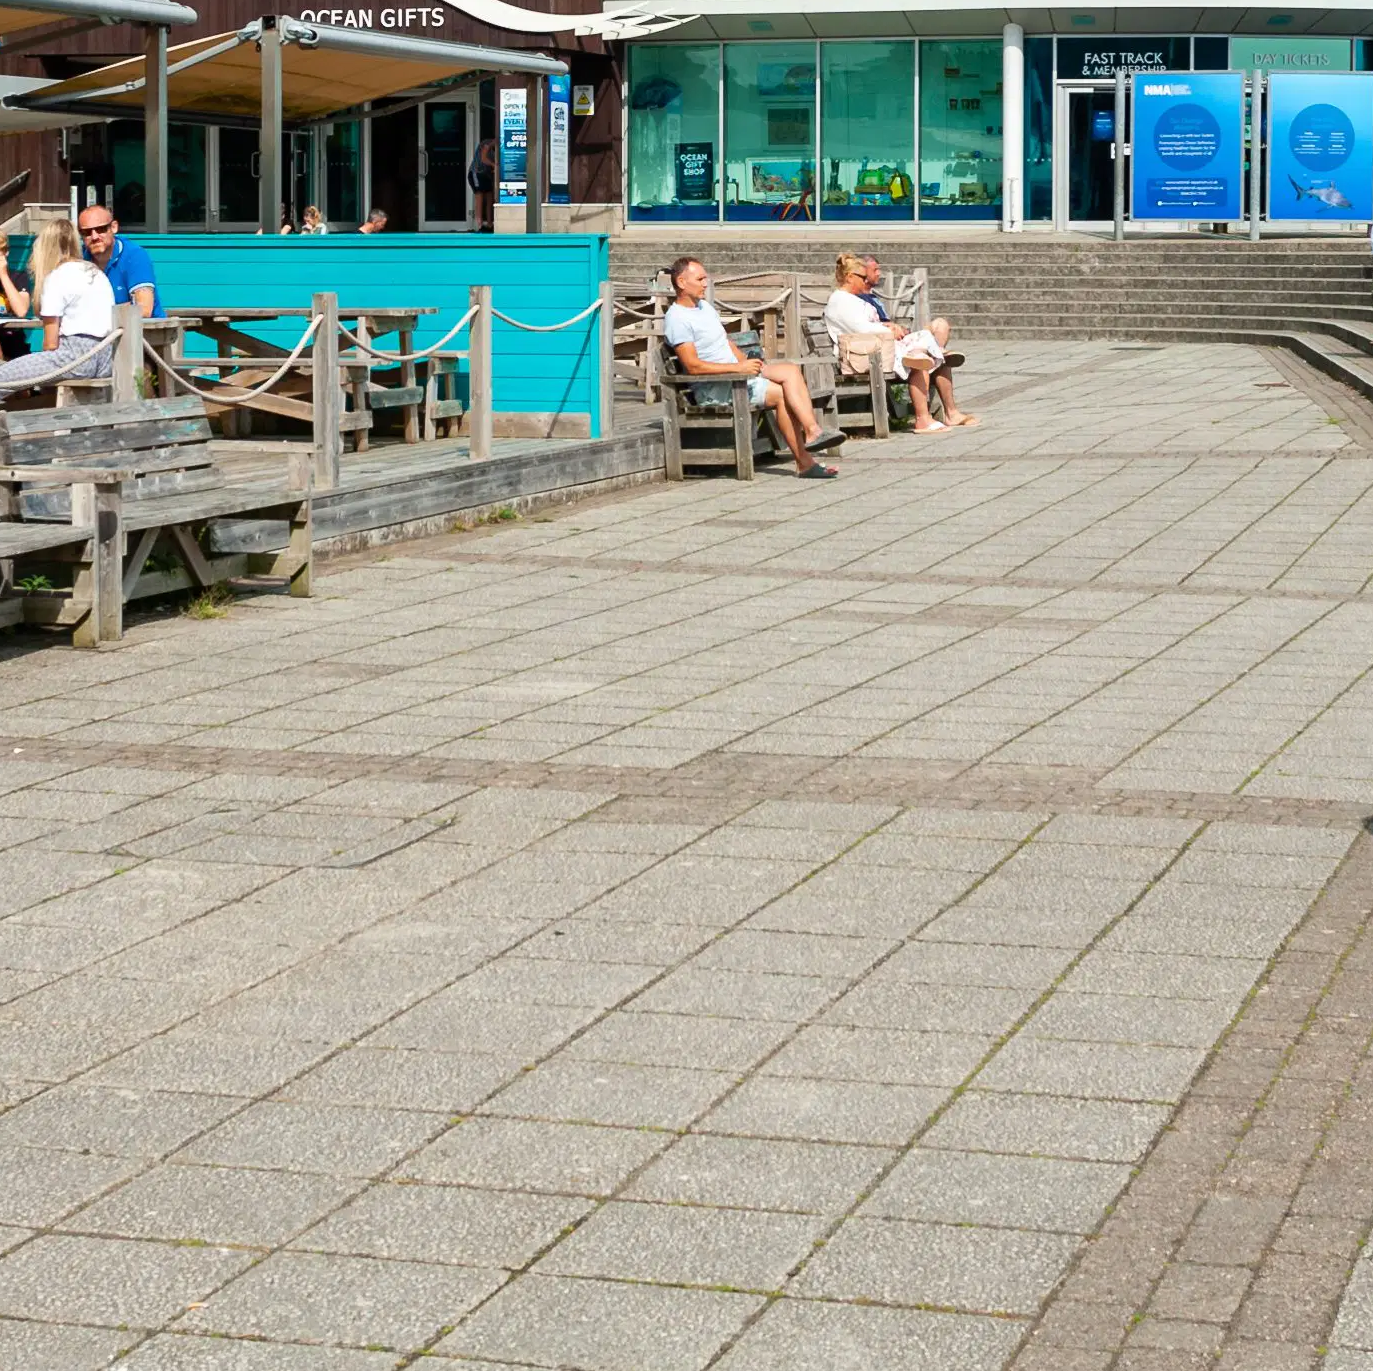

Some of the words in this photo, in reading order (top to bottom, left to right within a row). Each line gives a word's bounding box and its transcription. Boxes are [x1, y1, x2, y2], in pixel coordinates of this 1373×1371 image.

[301, 9, 373, 28] OCEAN
[380, 8, 445, 28] GIFTS
[1084, 53, 1116, 64] FAST
[1119, 52, 1163, 64] TRACK
[1253, 53, 1278, 65] DAY
[1280, 53, 1330, 66] TICKETS
[1082, 66, 1090, 76] &
[680, 153, 708, 162] OCEAN
